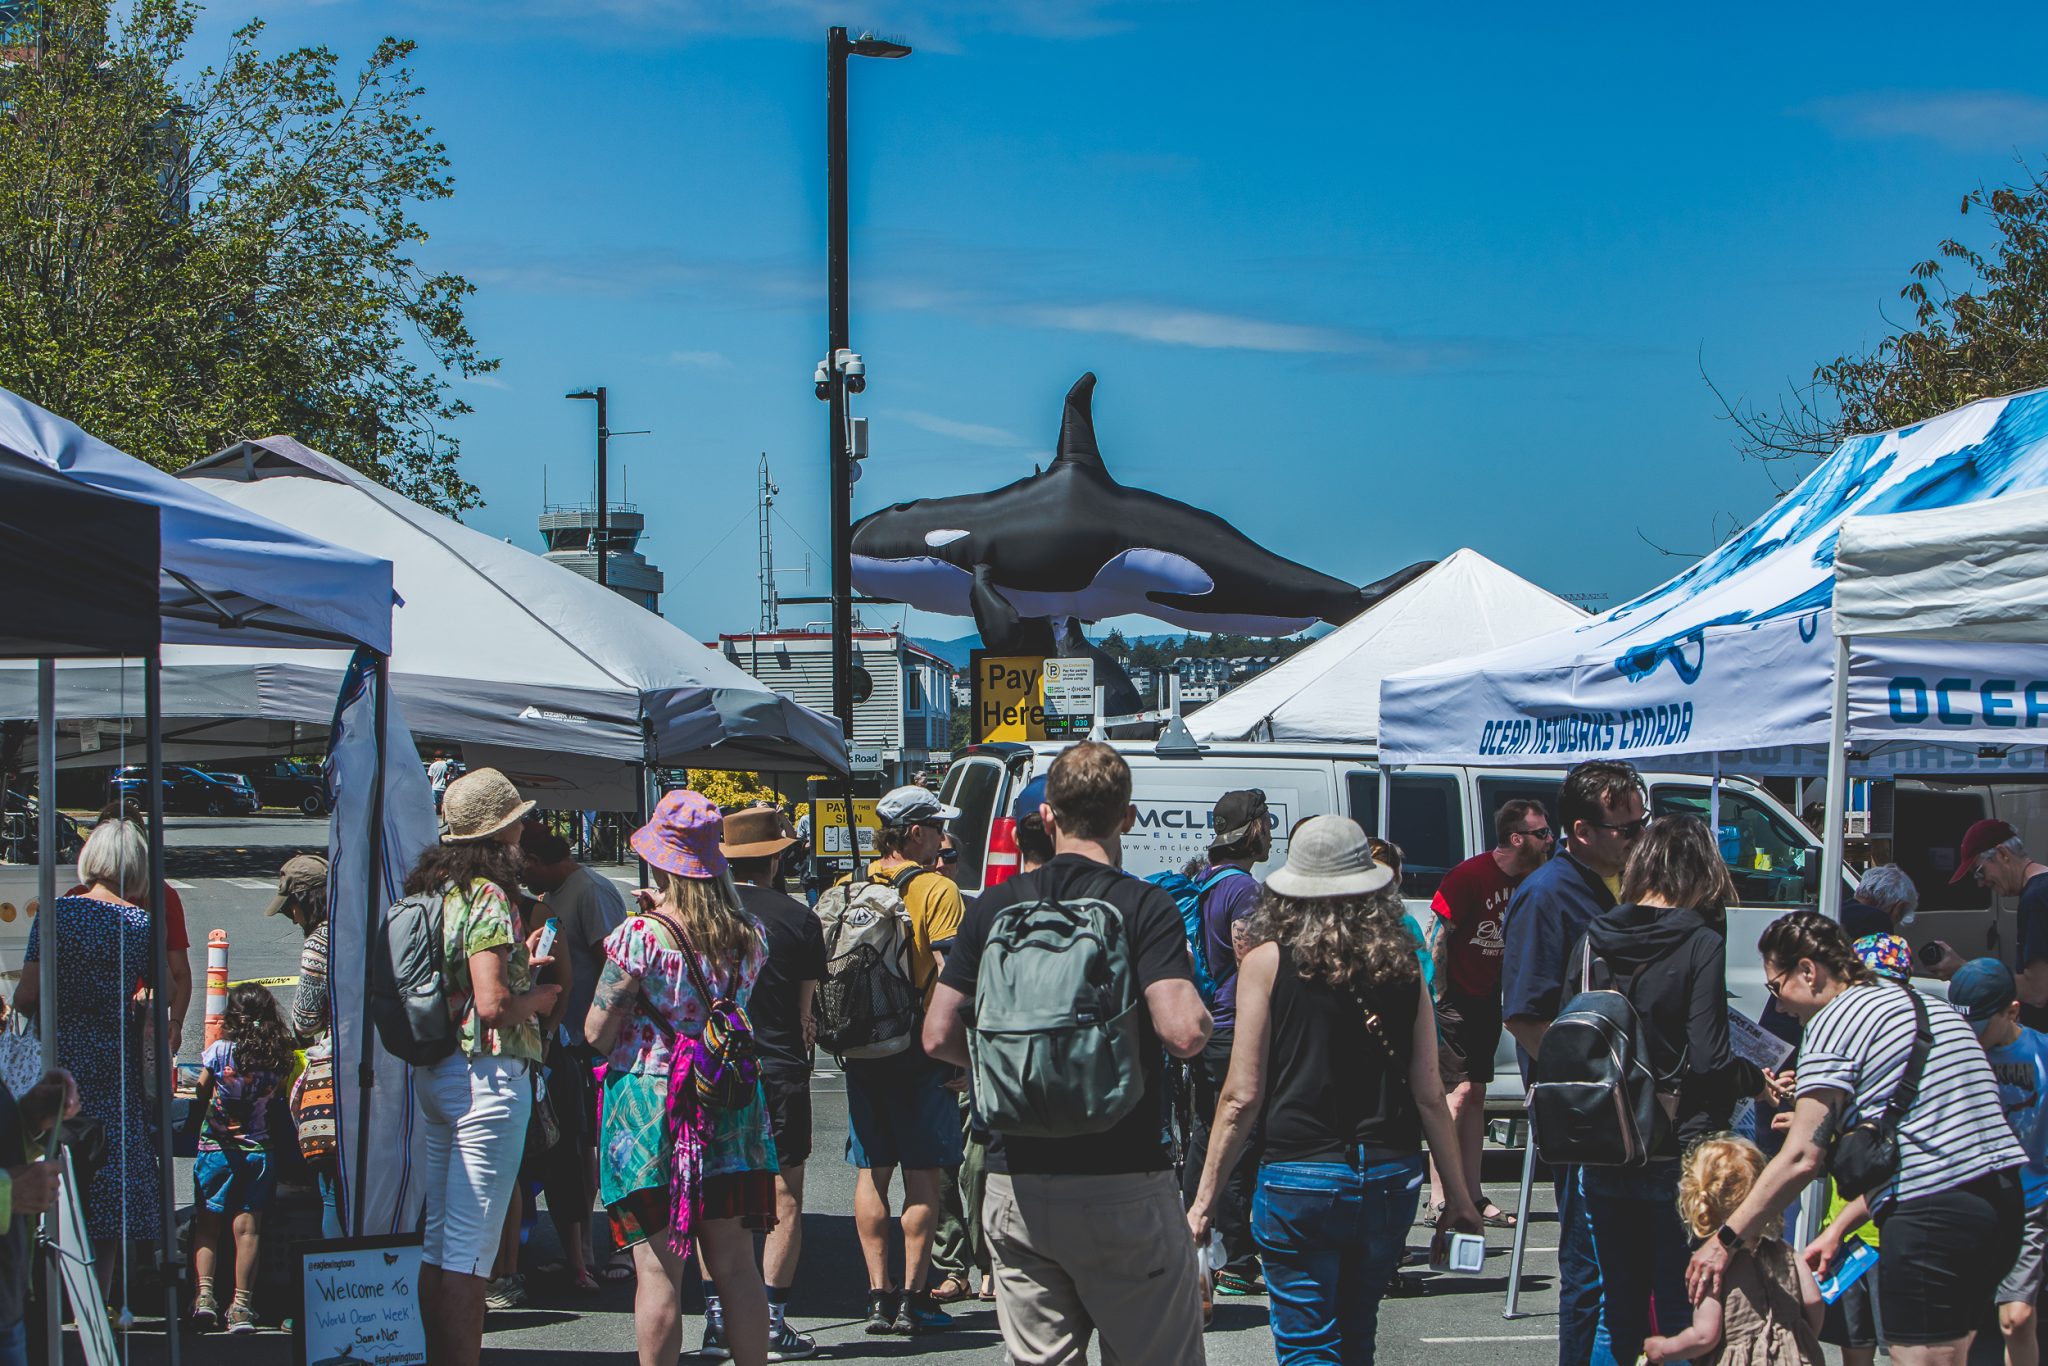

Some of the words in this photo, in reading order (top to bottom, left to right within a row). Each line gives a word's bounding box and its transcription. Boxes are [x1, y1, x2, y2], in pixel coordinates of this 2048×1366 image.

[989, 664, 1037, 695] Pay
[984, 701, 1044, 726] Here
[1479, 719, 1531, 755] OCEAN
[1531, 712, 1615, 754] NETWORKS
[1619, 701, 1694, 750] CANADA
[855, 754, 878, 762] Road
[826, 803, 846, 813] PAY
[835, 814, 862, 823] SIN
[1153, 832, 1219, 840] ELECT
[308, 1259, 355, 1271] @eaglewingtours
[315, 1276, 384, 1302] Welcome
[391, 1276, 409, 1296] To
[315, 1311, 346, 1329] World
[349, 1309, 377, 1325] Ocean
[382, 1304, 416, 1322] Week!
[355, 1327, 374, 1344] Sam
[374, 1352, 424, 1366] #eaglewingtours
